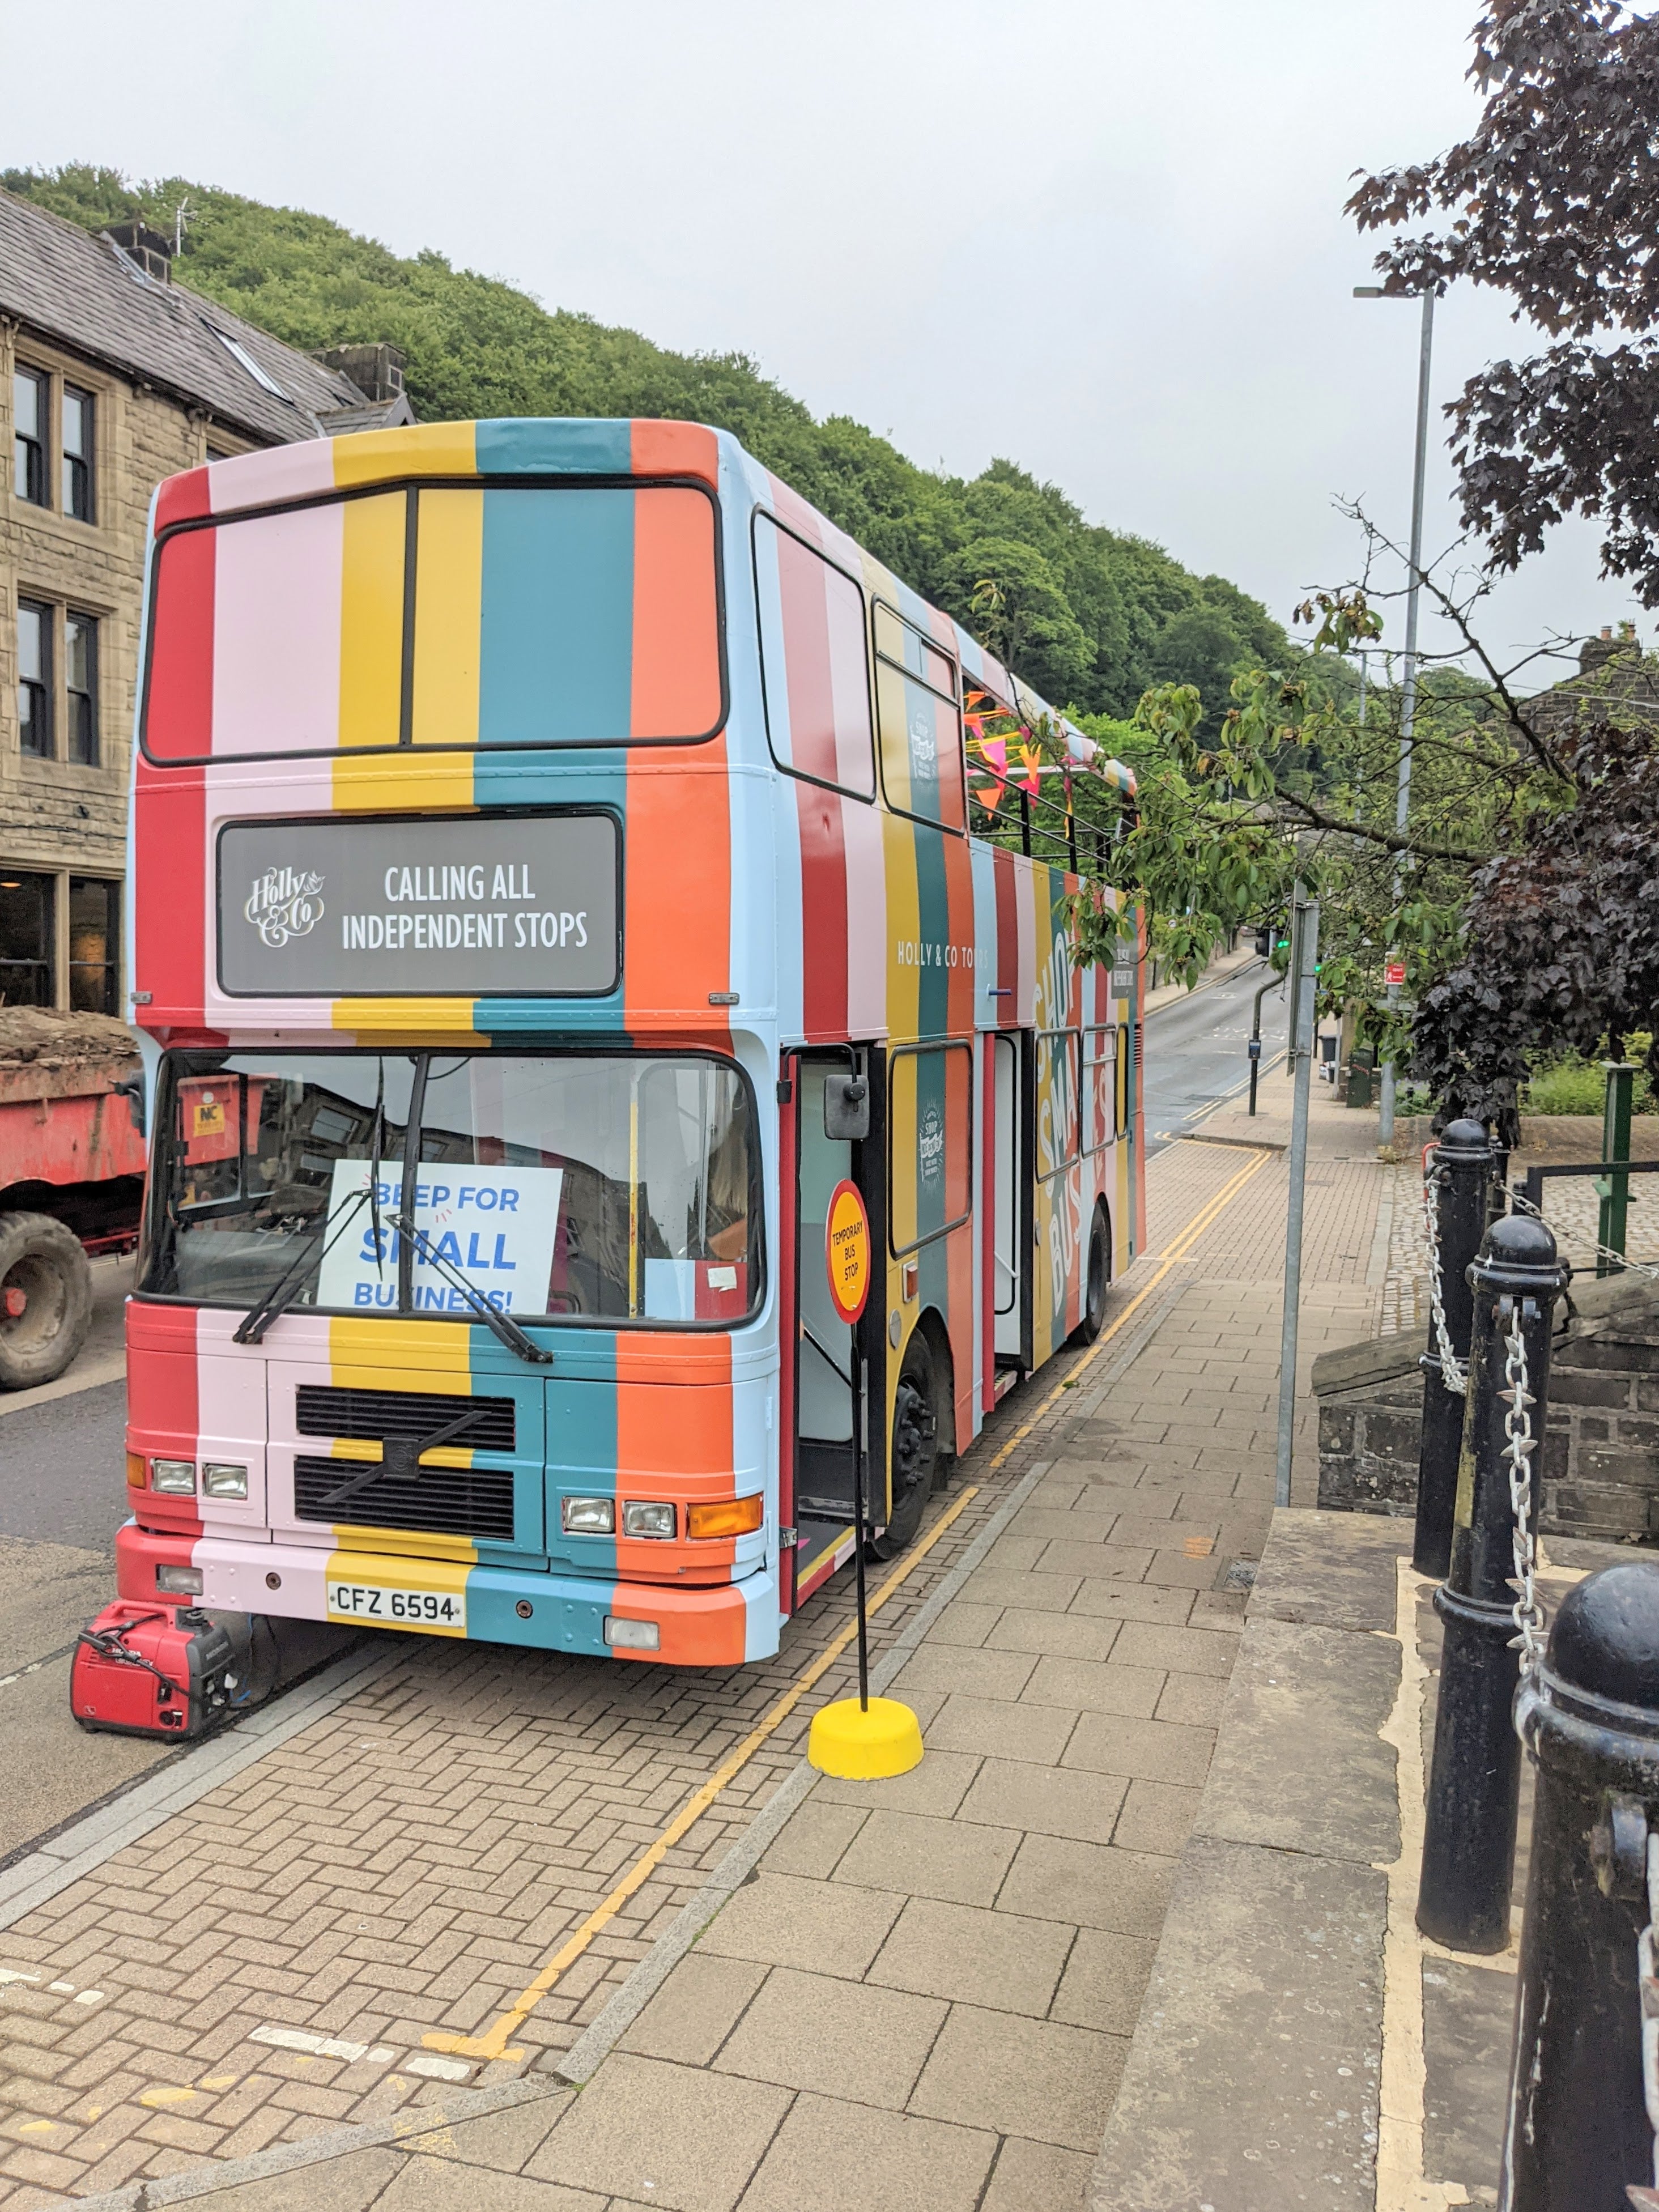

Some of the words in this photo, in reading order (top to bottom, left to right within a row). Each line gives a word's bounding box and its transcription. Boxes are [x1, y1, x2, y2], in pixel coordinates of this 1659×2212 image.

[249, 866, 309, 916] Holly
[385, 865, 484, 901] CALLING
[491, 864, 536, 900] ALL
[259, 904, 290, 948] &
[290, 897, 315, 930] Co
[343, 913, 508, 950] INDEPENDENT
[514, 912, 588, 948] STOPS
[897, 940, 933, 967] HOLLY
[935, 944, 942, 967] &
[945, 945, 958, 968] CO
[925, 1120, 938, 1135] SHOP
[372, 1182, 450, 1208] BEEP
[457, 1187, 520, 1212] FOR
[359, 1227, 517, 1270] SMALL
[832, 1220, 863, 1247] TEMPORARY
[844, 1244, 856, 1261] BUS
[844, 1262, 858, 1281] STOP
[354, 1282, 513, 1314] BUINESS!
[337, 1586, 382, 1614] CFZ
[392, 1593, 454, 1621] 6594
[112, 1647, 142, 1657] HODA
